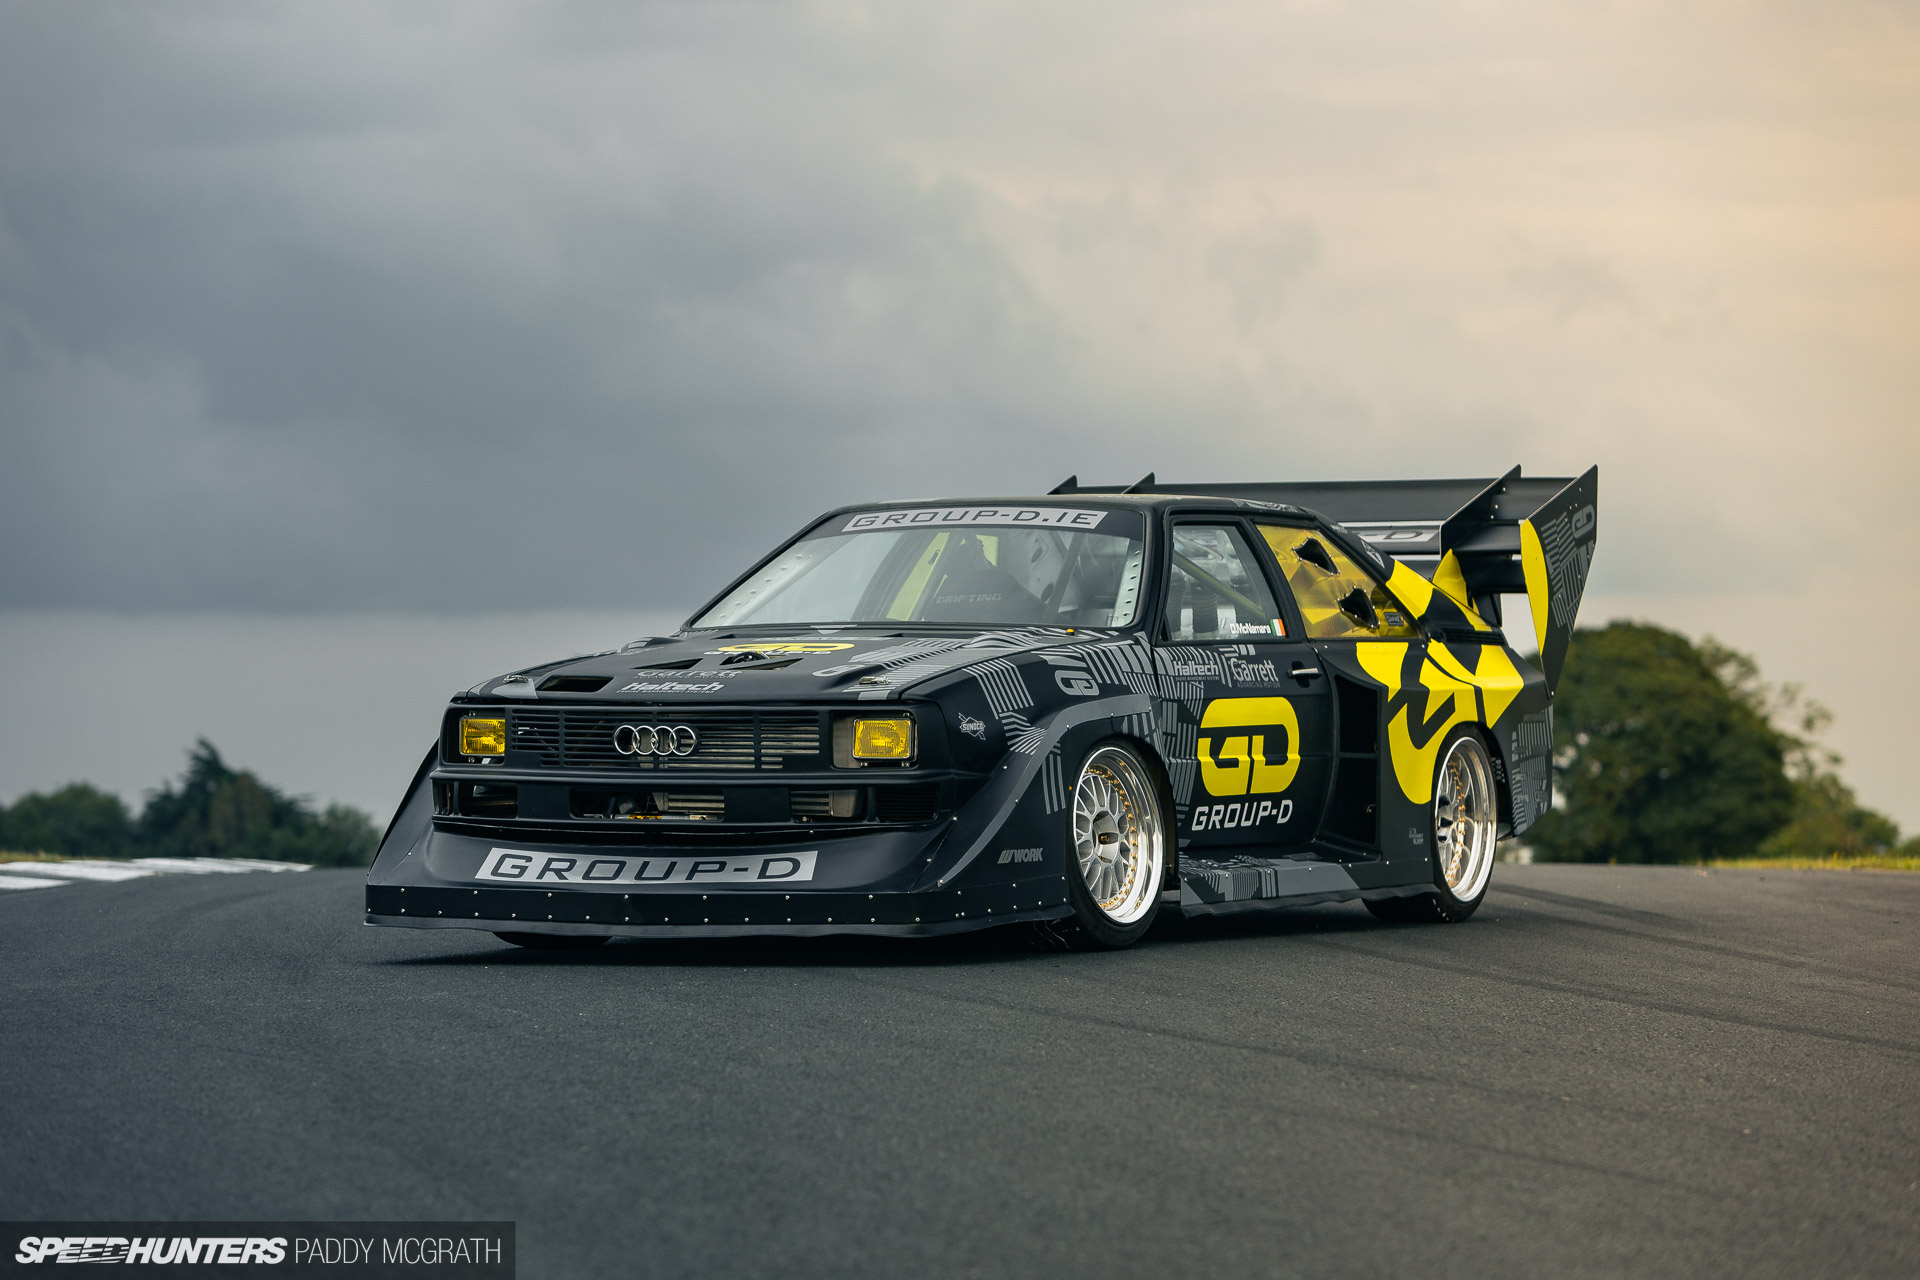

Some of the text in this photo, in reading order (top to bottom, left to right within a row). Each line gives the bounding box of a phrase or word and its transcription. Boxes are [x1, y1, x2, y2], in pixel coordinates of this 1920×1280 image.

[852, 510, 1098, 527] GROUP-D.IE
[1230, 623, 1272, 635] D.McNamara
[1173, 660, 1219, 676] Haltech
[1228, 657, 1279, 682] Garrett
[621, 682, 724, 691] Haltech
[962, 722, 985, 731] SUNOCO
[1191, 800, 1293, 831] GROUP-D
[1014, 848, 1043, 862] WORK
[491, 853, 801, 881] GROUP-D
